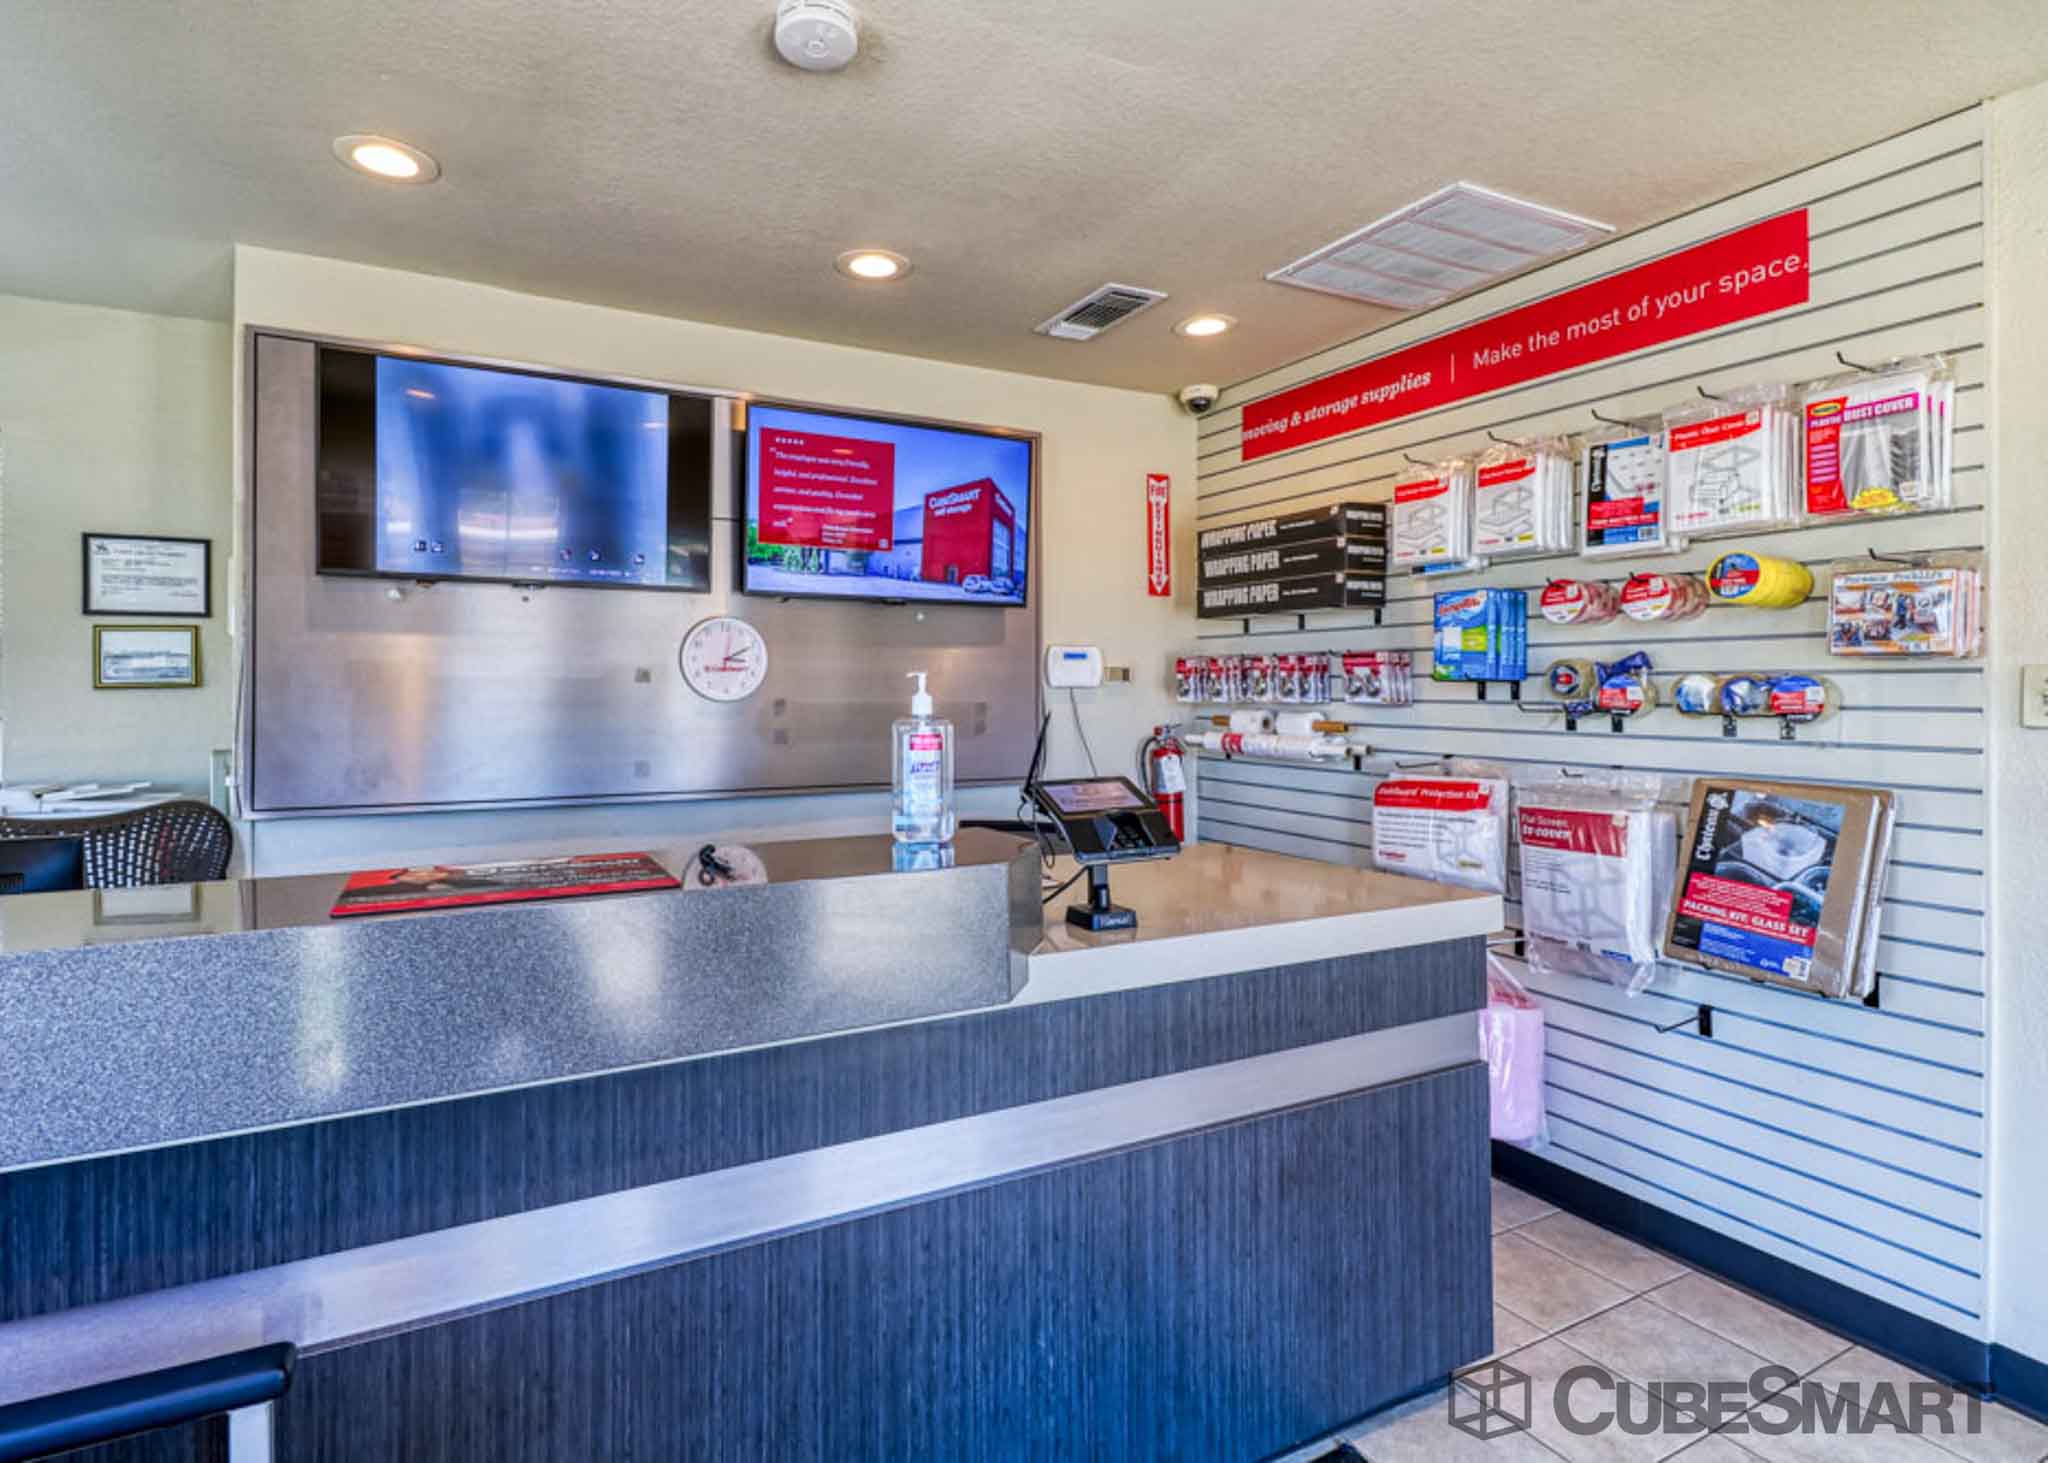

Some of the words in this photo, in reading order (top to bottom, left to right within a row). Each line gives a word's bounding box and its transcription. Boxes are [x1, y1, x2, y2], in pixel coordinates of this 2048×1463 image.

[1242, 417, 1289, 440] moving
[1290, 411, 1301, 427] &
[1303, 395, 1358, 421] storage
[1361, 372, 1431, 404] supplies
[1473, 340, 1522, 369] Make
[1528, 330, 1560, 352] the
[1567, 311, 1621, 341] most
[1627, 296, 1648, 321] of
[1655, 281, 1711, 318] your
[1718, 253, 1809, 294] space.
[1875, 397, 1913, 416] COVER
[1201, 525, 1247, 549] WRAPPING
[1247, 519, 1277, 541] PAPER
[1204, 555, 1249, 579] WRAPPING
[1251, 550, 1280, 572] PAPER
[1204, 588, 1249, 608] WRAPPING
[1250, 583, 1280, 604] PAPER
